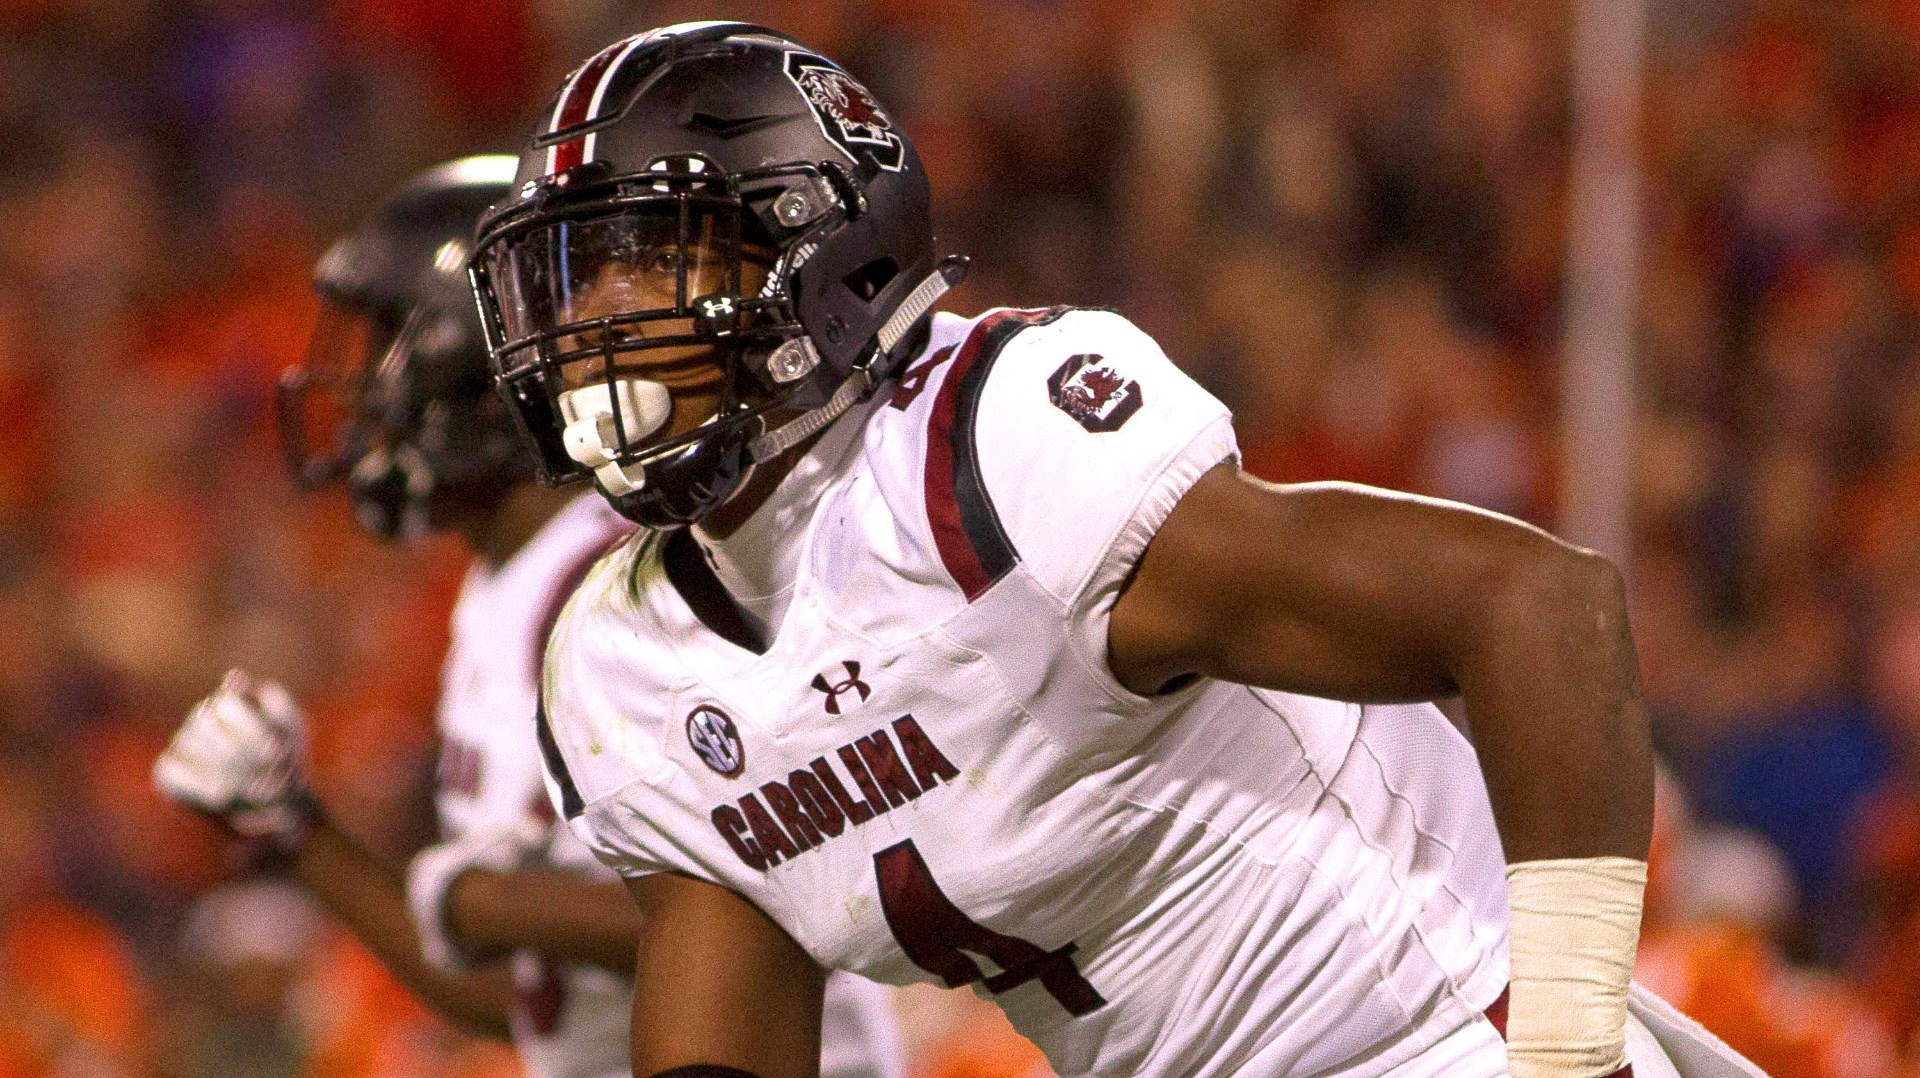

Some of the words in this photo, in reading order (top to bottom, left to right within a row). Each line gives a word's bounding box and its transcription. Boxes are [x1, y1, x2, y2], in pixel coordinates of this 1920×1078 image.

[689, 709, 740, 773] SEC
[711, 713, 961, 872] CAROLINA
[873, 838, 1109, 1018] 4
